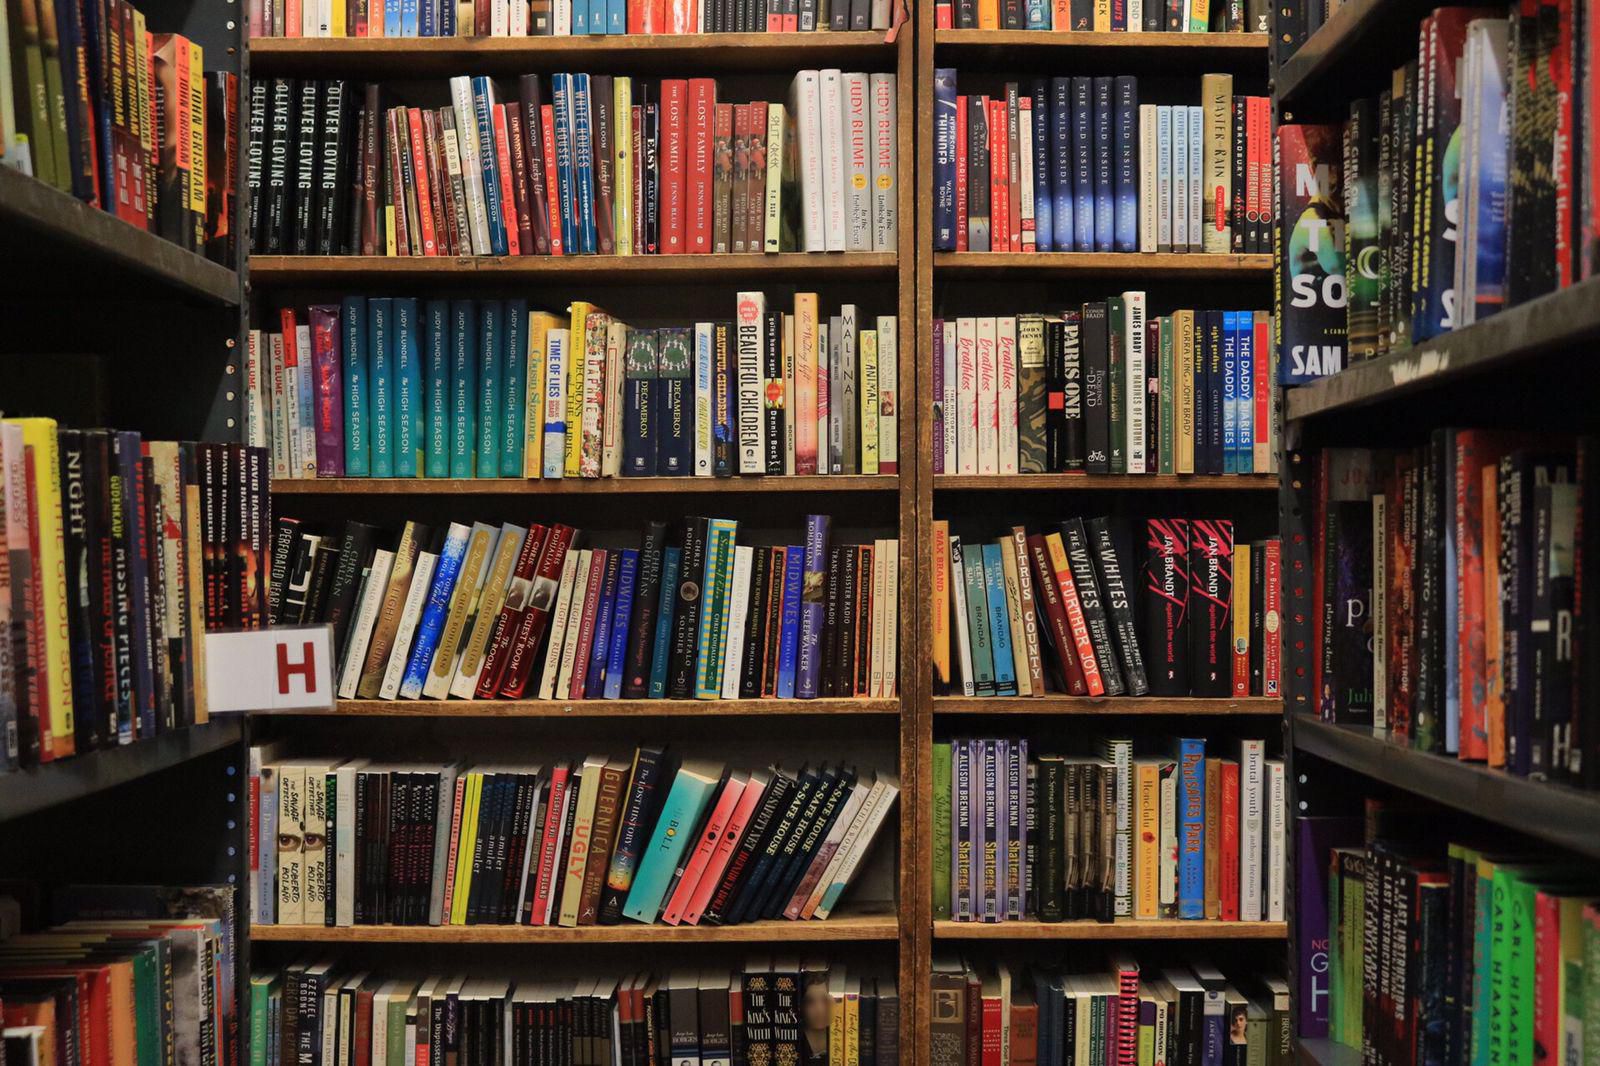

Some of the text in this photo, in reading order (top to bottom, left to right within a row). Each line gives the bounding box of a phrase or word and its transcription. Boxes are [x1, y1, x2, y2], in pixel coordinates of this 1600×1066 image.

[192, 88, 204, 202] JOHN GRISHAM
[249, 86, 265, 188] OLIVER LOVING
[271, 85, 288, 187] OLIVER LOVING
[298, 87, 316, 189] OLIVER LOVING
[322, 87, 340, 189] OLIVER LOVING
[475, 93, 493, 171] WHITE HOUSES
[554, 90, 569, 167] WHITE HOUSES
[670, 100, 678, 128] LOST
[698, 100, 706, 174] LOST FAMILY
[850, 79, 864, 169] JUDY BLUME
[877, 79, 891, 169] JUDY BLUME
[1215, 95, 1225, 140] MASTER
[671, 131, 679, 174] FAMILY
[1215, 150, 1227, 178] RAIN
[842, 315, 853, 395] MALINA
[1064, 324, 1080, 380] PARIS
[1132, 306, 1142, 354] JAMES BRADY
[1291, 345, 1342, 376] SAM
[274, 364, 282, 396] BLUME
[549, 339, 561, 398] TIME OF LIES
[739, 325, 758, 447] BEAUTIFUL CHILDREN
[1065, 382, 1080, 419] ONE
[1087, 374, 1096, 407] DEAD
[1224, 336, 1234, 444] THE DADDY DIARIES
[1241, 336, 1250, 444] THE DADDY DIARIES
[68, 452, 85, 536] NIGHT
[250, 455, 260, 551] DAVID HAGBERG
[272, 527, 292, 578] PERFORATED
[529, 542, 539, 564] CHRIS
[555, 542, 565, 565] CHRIS
[1069, 530, 1099, 608] THE WHITES
[1100, 530, 1128, 608] THE WHITES
[1164, 536, 1174, 597] JAN BRANDT
[1208, 537, 1218, 598] JAN BRANDT
[616, 558, 634, 628] MIDWIVES
[786, 554, 800, 625] MIDWIVES
[1015, 532, 1040, 679] CITRUS COUNTY
[485, 612, 508, 670] GUEST ROOM
[511, 612, 533, 670] GUEST ROOM
[1061, 580, 1097, 676] FURTHER JOY
[276, 642, 316, 694] H
[290, 792, 299, 823] SAVAGE
[316, 791, 324, 822] SAVAGE
[592, 771, 620, 854] GUERNICA
[959, 754, 968, 828] ALLISON BRENNAN
[985, 754, 995, 828] ALLISON BRENNAN
[1010, 754, 1018, 827] ALLISON BRENNAN
[1183, 753, 1202, 853] PALISADES PARK
[1246, 753, 1259, 817] brutal youth
[766, 792, 807, 856] SAFE HOUSE
[784, 791, 824, 855] SAFE HOUSE
[802, 790, 843, 852] SAFE HOUSE
[1026, 808, 1034, 831] COOL
[291, 862, 300, 903] ROBERTO
[568, 825, 590, 880] UGLY
[307, 977, 318, 1020] EZEKIEL
